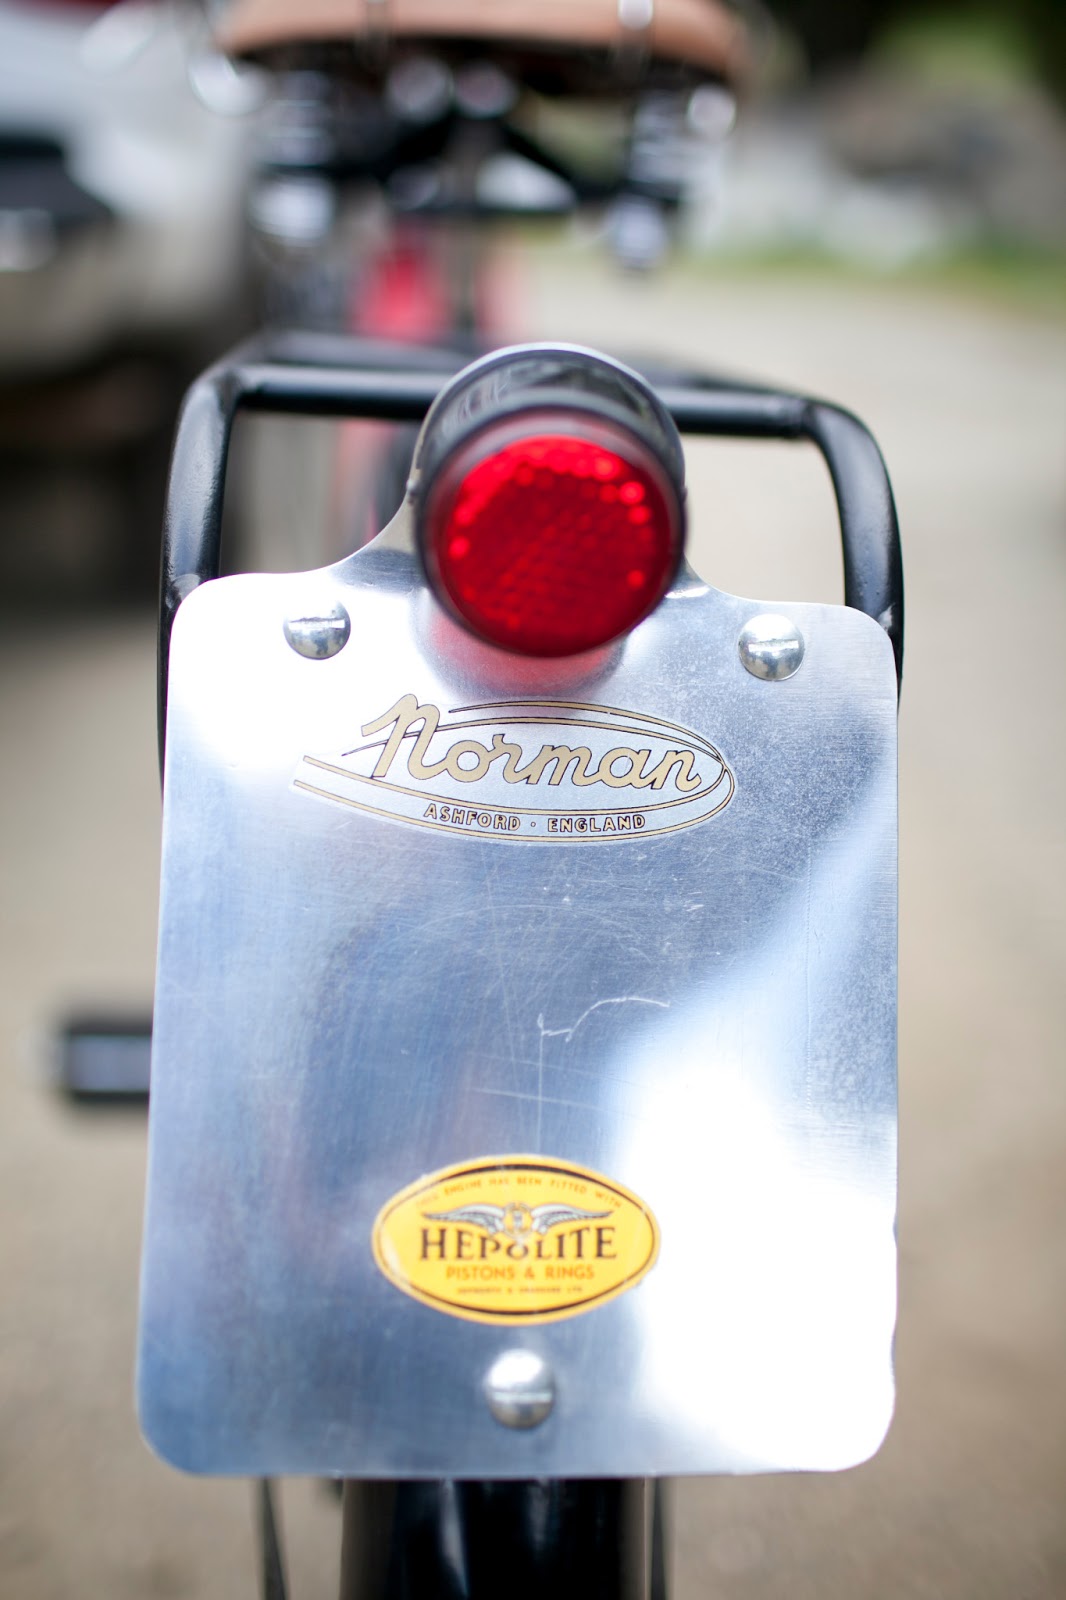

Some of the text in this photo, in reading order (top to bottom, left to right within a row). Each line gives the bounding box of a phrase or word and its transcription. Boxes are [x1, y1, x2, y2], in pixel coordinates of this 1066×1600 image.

[361, 693, 702, 792] Norman
[424, 803, 646, 832] ASHFORD ENGLAND
[420, 1226, 617, 1260] HEPOLITE
[446, 1264, 595, 1280] PISTONS & RINGS
